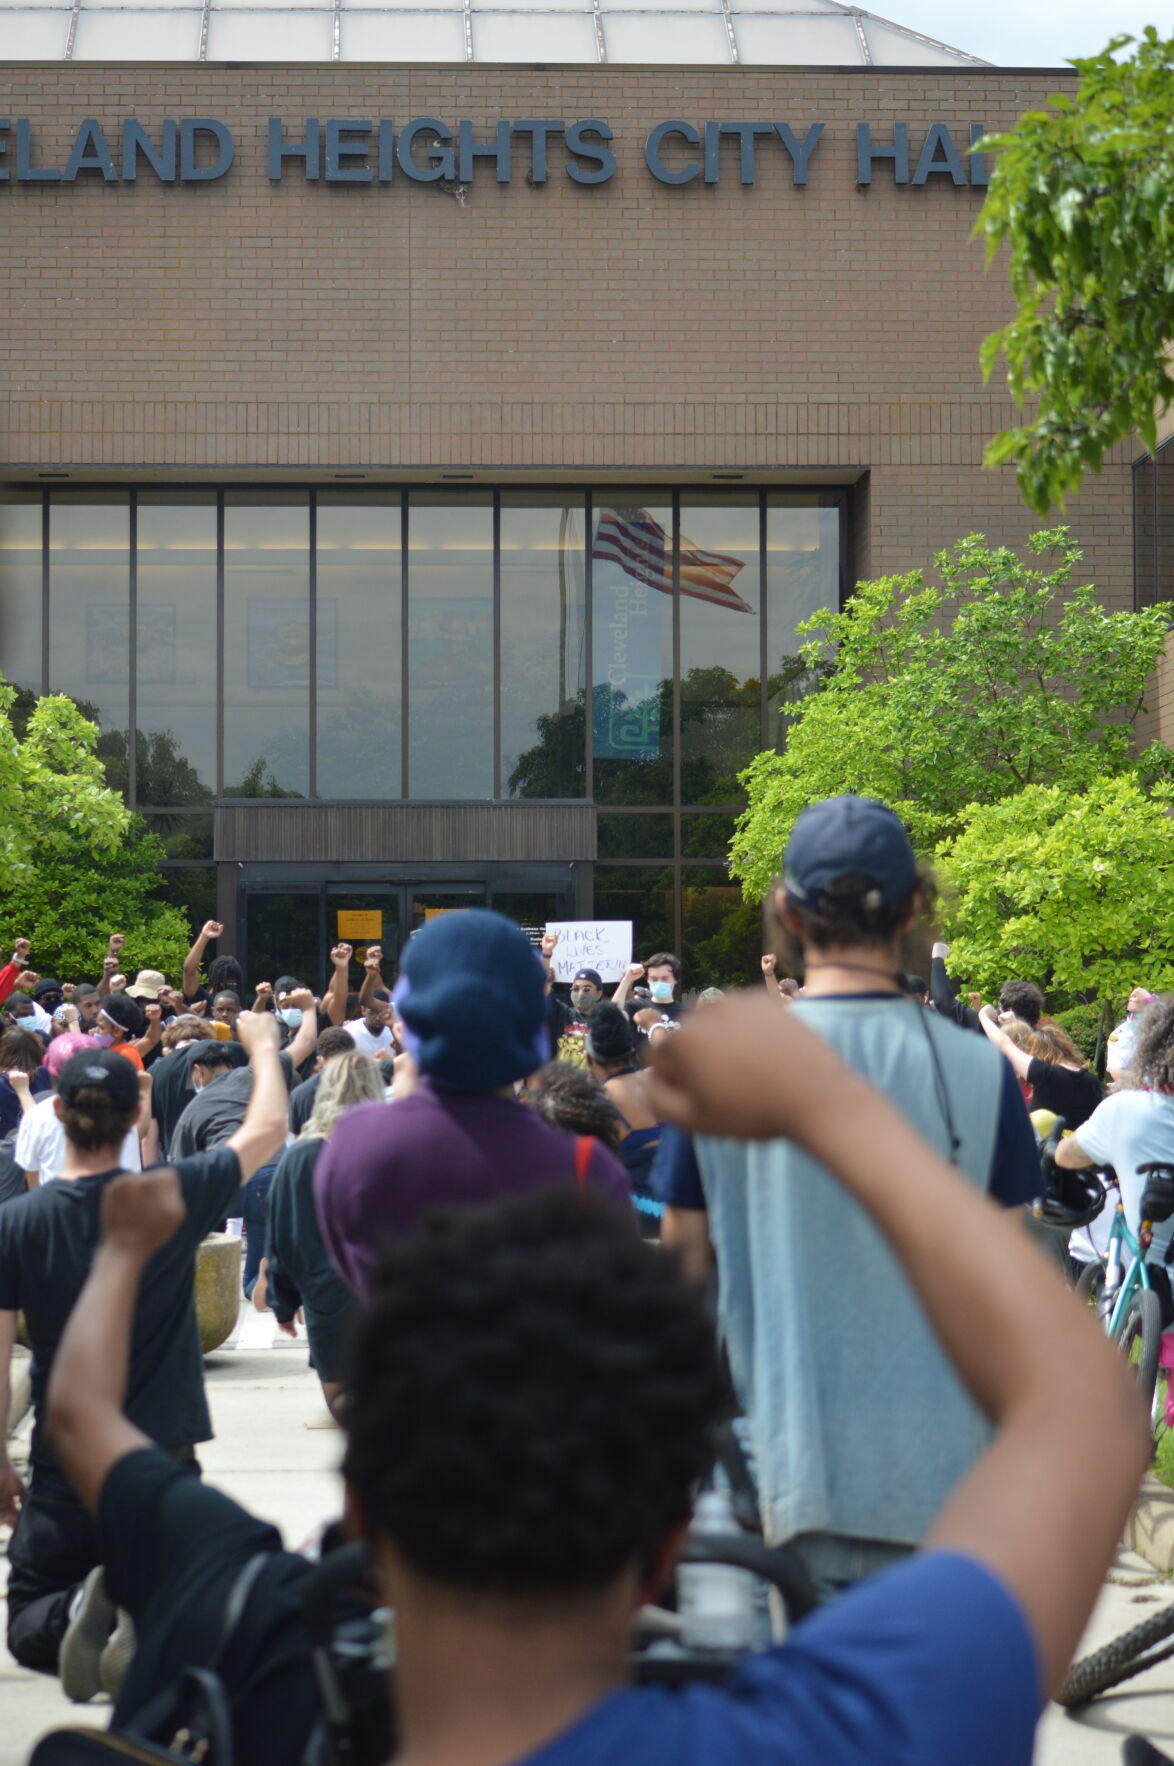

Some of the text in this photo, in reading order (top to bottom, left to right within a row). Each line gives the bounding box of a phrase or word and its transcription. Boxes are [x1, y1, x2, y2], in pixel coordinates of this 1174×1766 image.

[0, 117, 990, 187] LAND HEIGHTS CITY HAL
[607, 583, 629, 686] Cleveland
[554, 927, 609, 943] BLACK
[566, 944, 604, 958] LIVES
